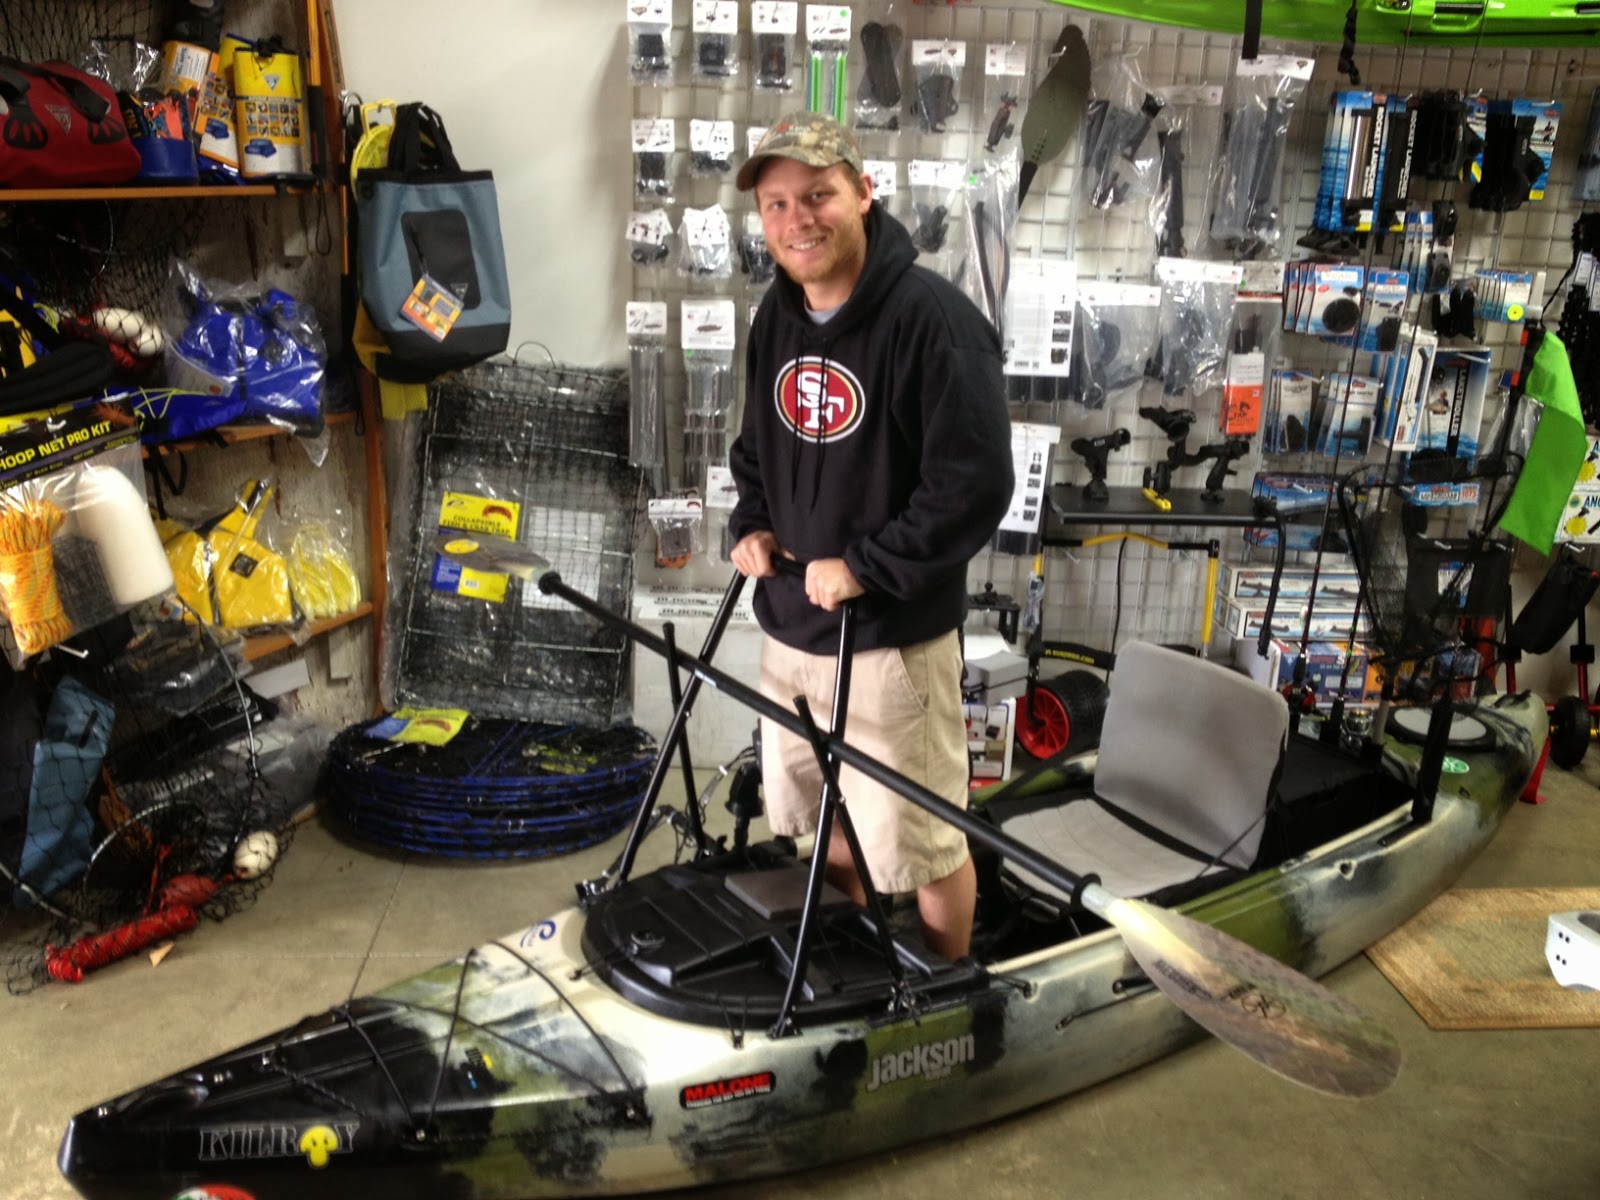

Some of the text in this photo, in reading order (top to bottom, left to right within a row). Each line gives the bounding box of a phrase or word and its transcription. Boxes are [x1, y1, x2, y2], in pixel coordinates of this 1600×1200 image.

[1367, 106, 1385, 199] ROCKET LAUNCHER
[1408, 109, 1418, 147] ROCKET
[1400, 148, 1413, 199] LAUNCHER
[0, 449, 36, 471] HOOP
[38, 437, 65, 457] NET
[66, 430, 90, 446] PRO
[91, 420, 111, 437] KIT
[686, 1072, 770, 1100] MALONE
[867, 1034, 974, 1091] jackson
